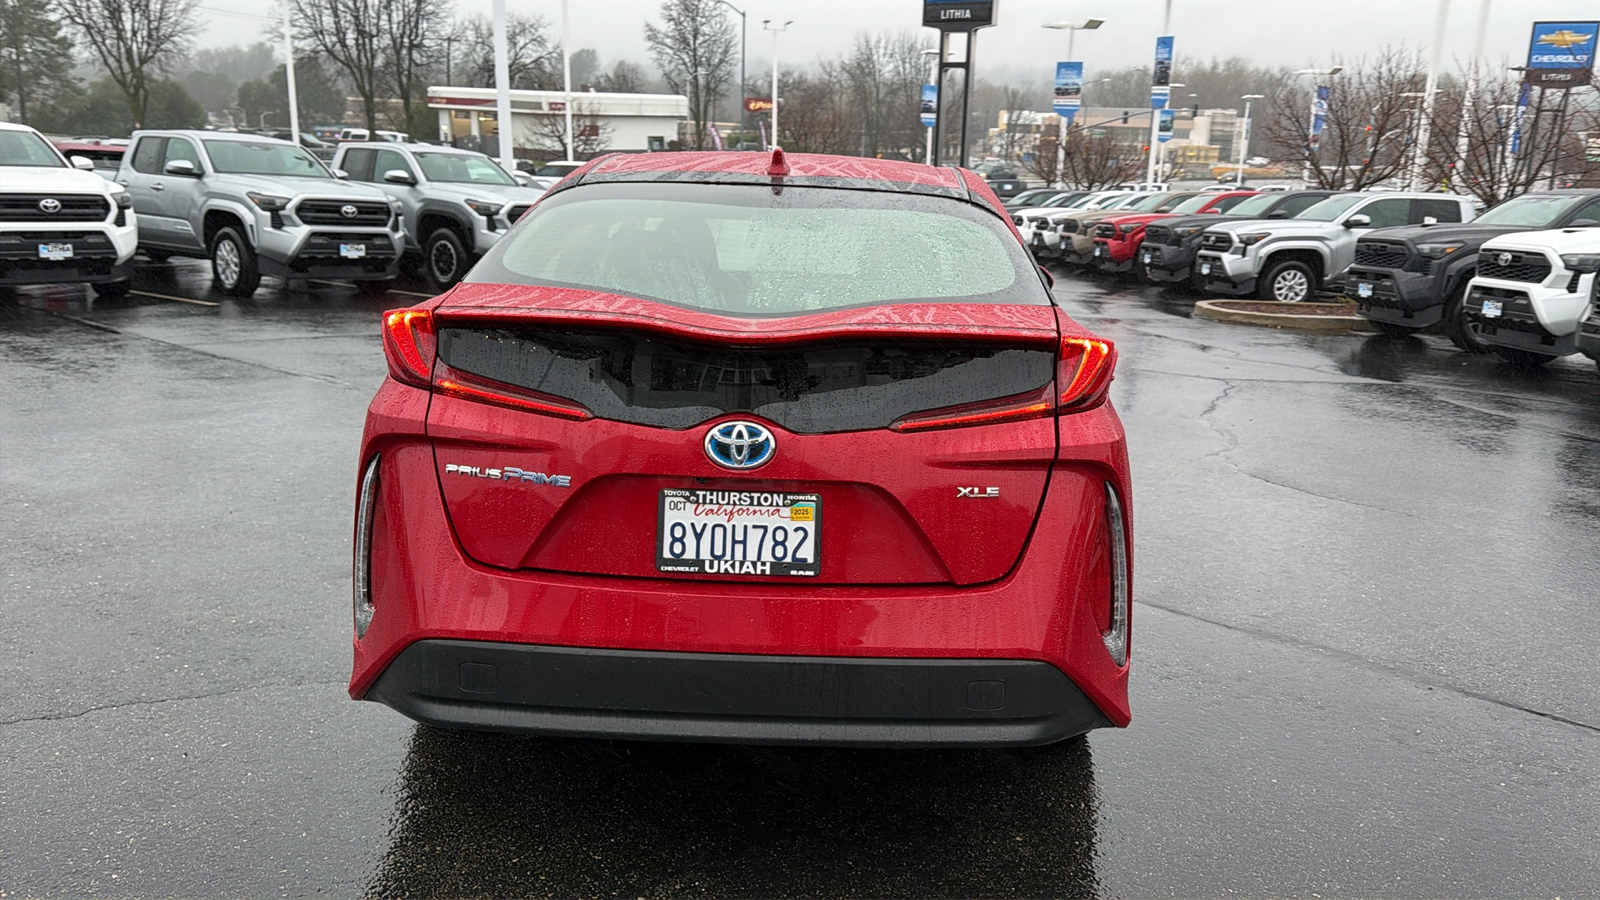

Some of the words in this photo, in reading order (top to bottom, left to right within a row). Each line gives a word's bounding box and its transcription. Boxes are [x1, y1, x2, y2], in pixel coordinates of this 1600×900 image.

[940, 9, 972, 19] LITHIA
[445, 464, 502, 479] PRIUS
[503, 467, 572, 487] PRIME
[696, 491, 784, 506] THURSTON
[956, 486, 1000, 498] XLE
[669, 500, 687, 511] OCT
[793, 508, 810, 516] 2025
[693, 503, 789, 522] California
[704, 560, 771, 575] UKIAH
